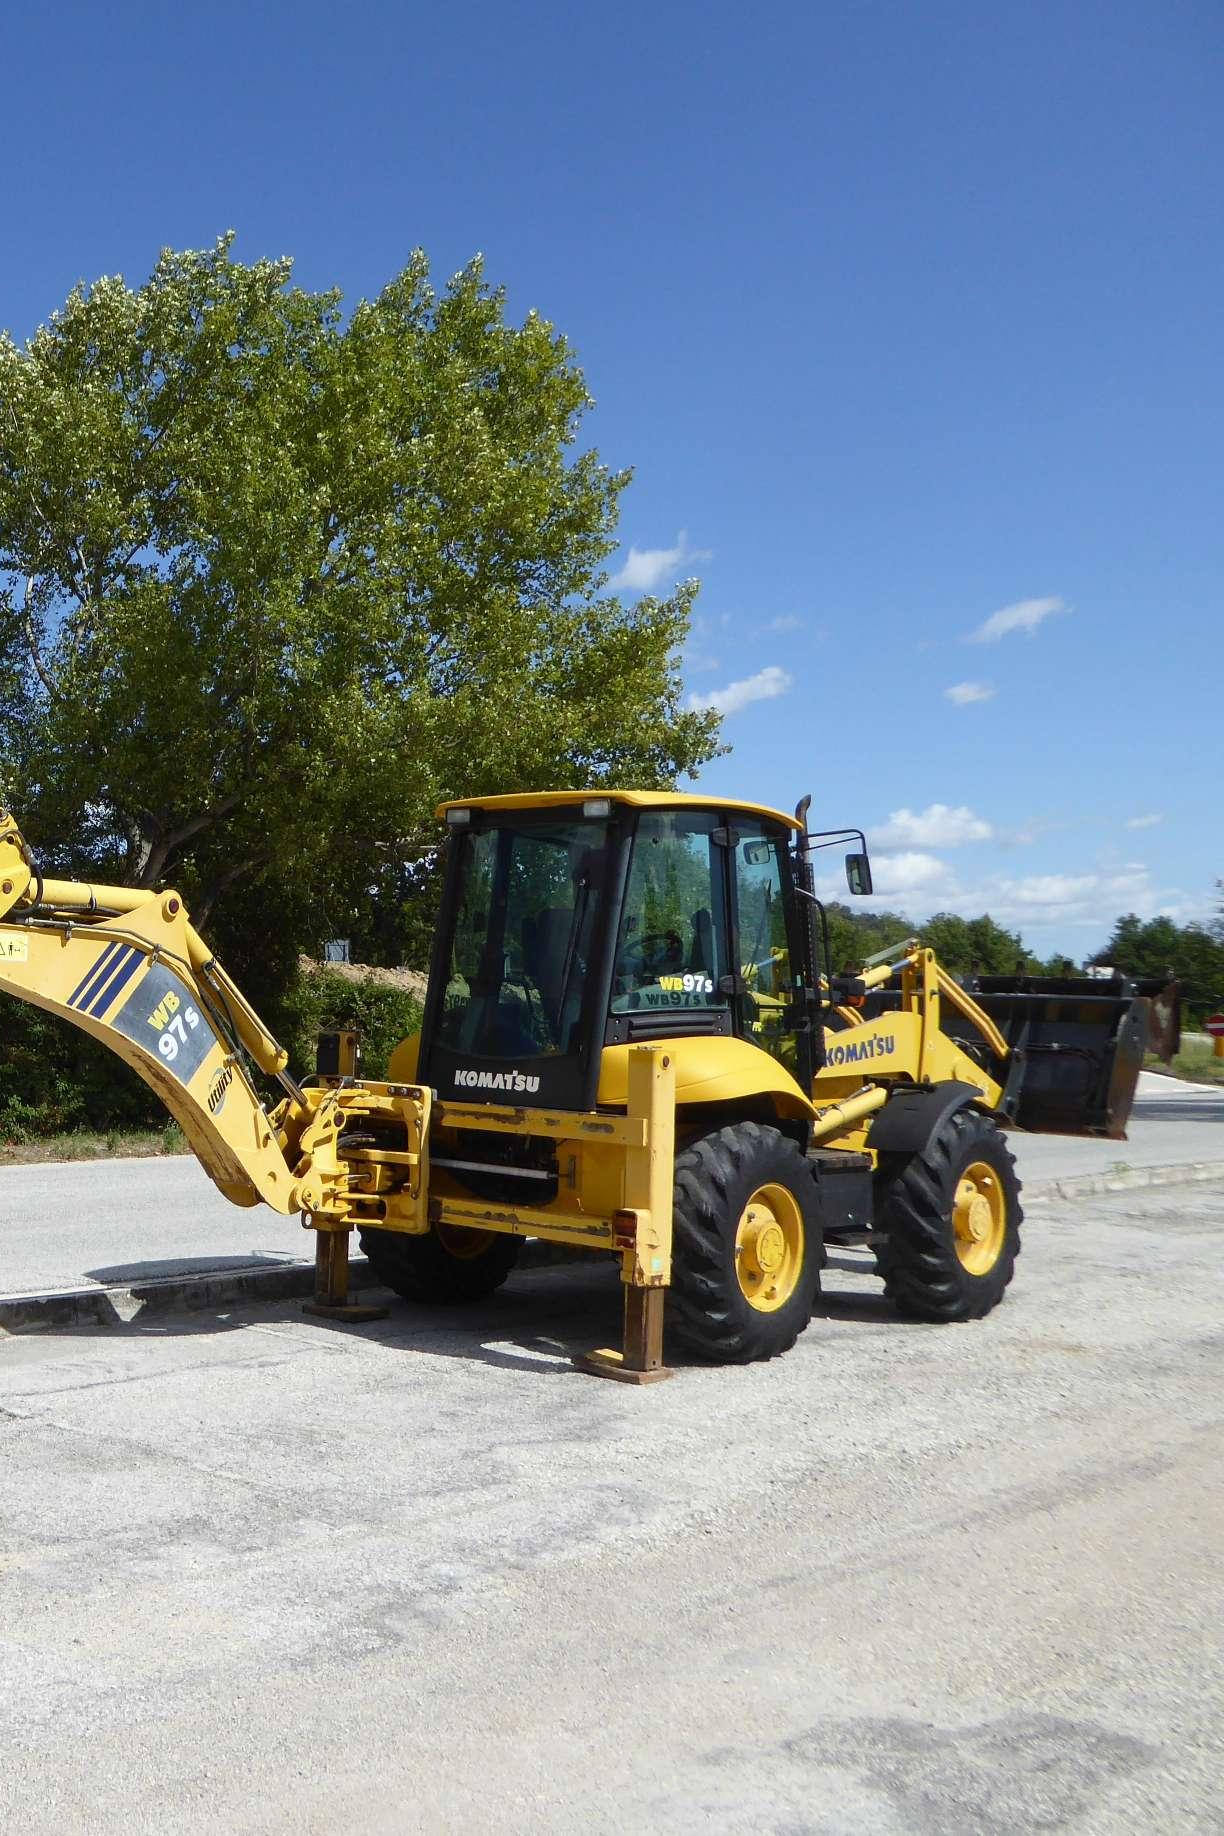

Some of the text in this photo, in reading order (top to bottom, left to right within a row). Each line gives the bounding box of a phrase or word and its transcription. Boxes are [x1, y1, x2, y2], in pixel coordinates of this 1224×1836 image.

[147, 990, 180, 1031] WB
[824, 1033, 895, 1067] KOMATSU
[454, 1070, 540, 1092] KOMATSU
